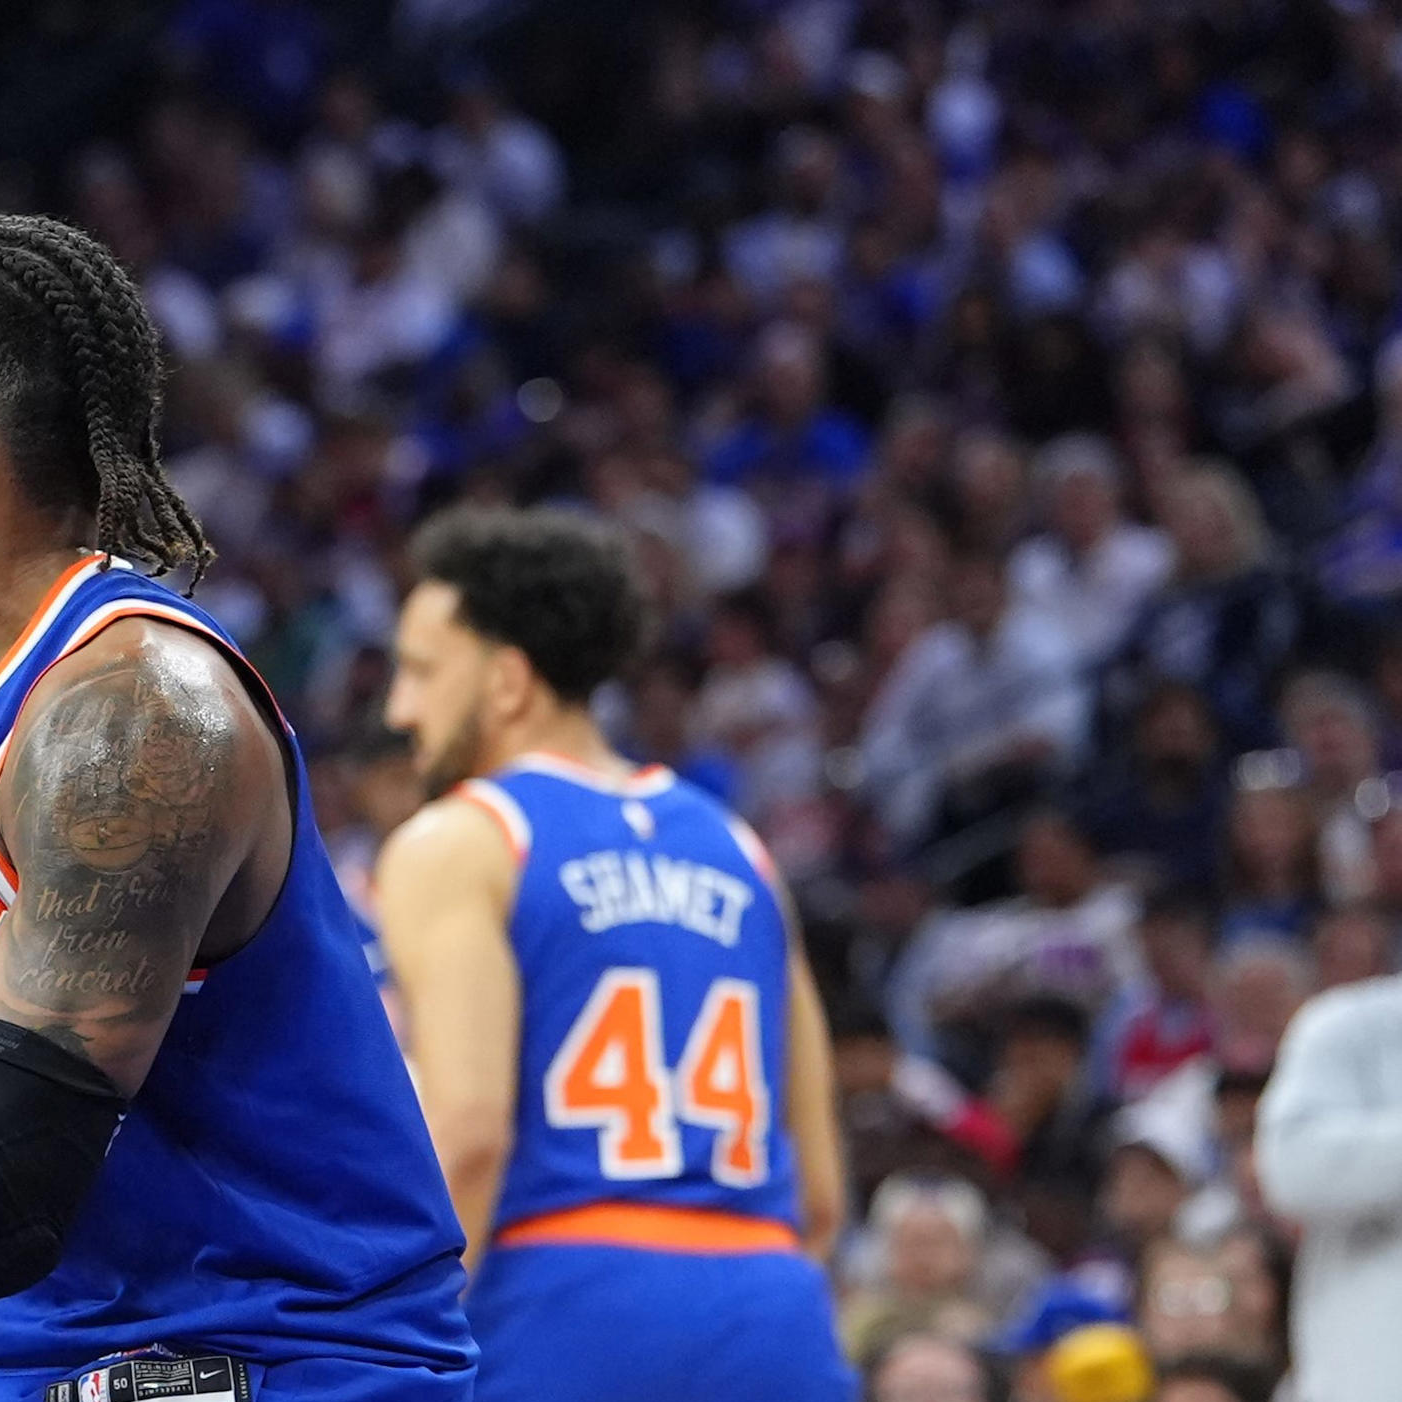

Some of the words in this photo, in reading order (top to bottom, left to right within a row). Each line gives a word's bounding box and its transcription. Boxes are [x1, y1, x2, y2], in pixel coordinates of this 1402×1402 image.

[36, 878, 107, 922] that
[559, 848, 755, 948] SHAMET
[43, 923, 129, 969] from
[19, 955, 156, 994] concrete
[543, 966, 770, 1190] 44
[113, 1378, 128, 1390] 50
